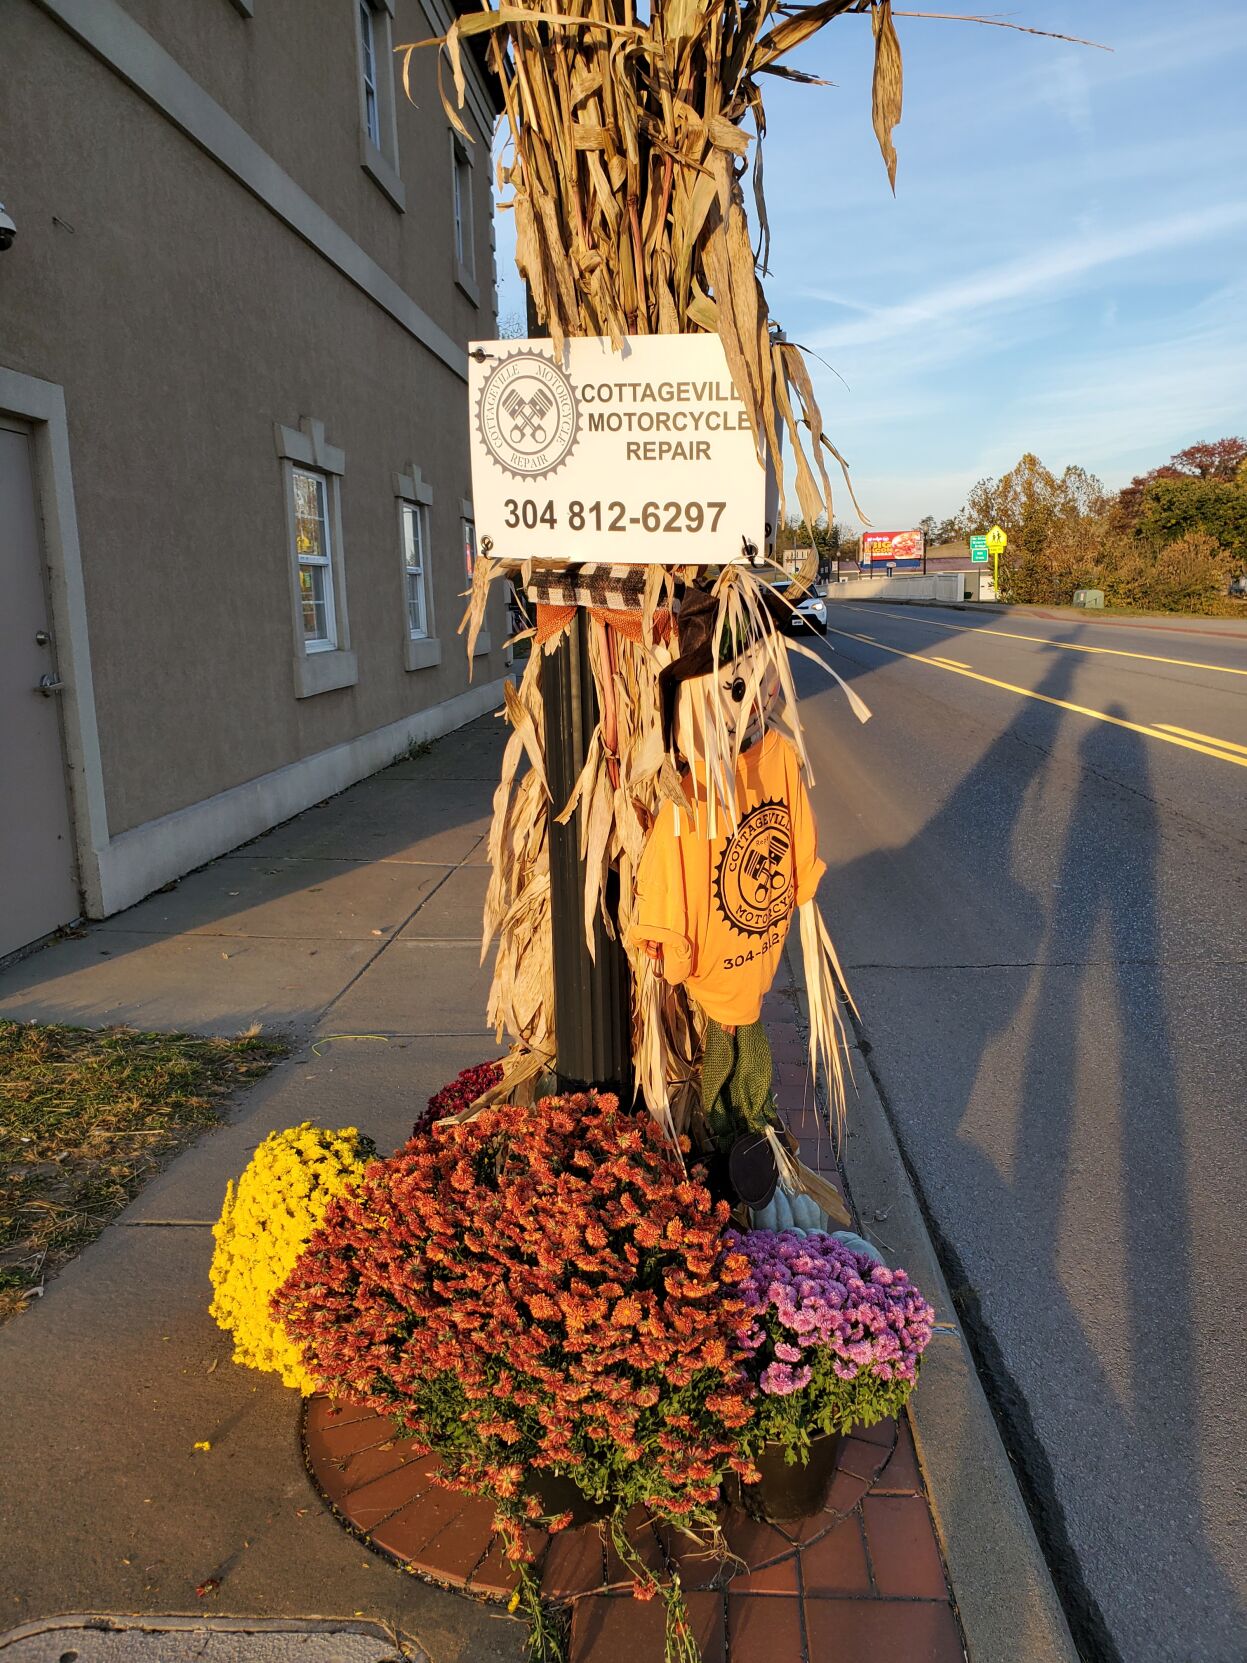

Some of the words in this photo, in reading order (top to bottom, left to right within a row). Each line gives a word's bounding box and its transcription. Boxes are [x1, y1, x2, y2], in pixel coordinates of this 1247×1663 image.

[535, 364, 573, 447] MOTORCYCLE
[581, 381, 742, 403] COTTAGEVILL
[486, 364, 520, 449] COTTAGEVILLE
[588, 410, 751, 432] MOTORCYCLE
[510, 452, 549, 469] REPAIR
[626, 441, 711, 460] REPAIR
[504, 498, 557, 530] 304
[568, 500, 727, 532] 812-6297
[728, 812, 791, 872] COTTAGEVILL
